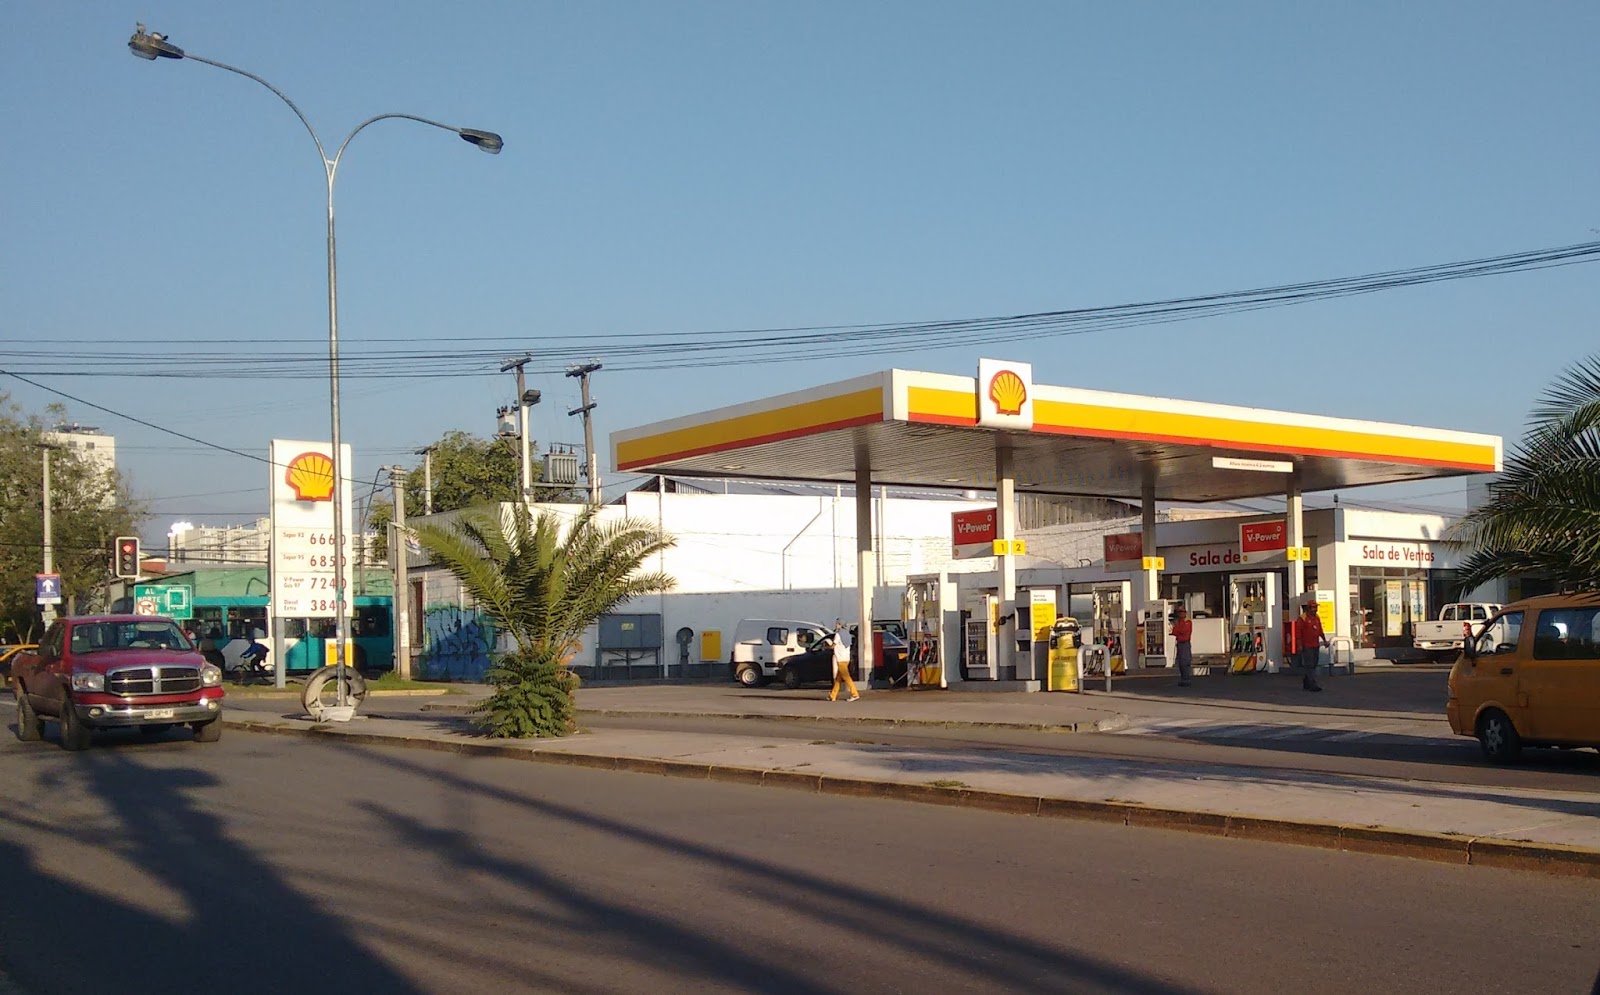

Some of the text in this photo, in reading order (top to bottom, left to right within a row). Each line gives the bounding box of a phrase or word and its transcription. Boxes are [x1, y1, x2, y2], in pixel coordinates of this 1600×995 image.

[957, 523, 991, 534] V-Power
[1246, 532, 1281, 543] V-Power
[1016, 543, 1021, 552] 2
[1109, 544, 1137, 552] V-Power
[1303, 549, 1308, 557] 4
[1362, 544, 1435, 562] Sala de Ventas
[1190, 549, 1240, 566] Sala de
